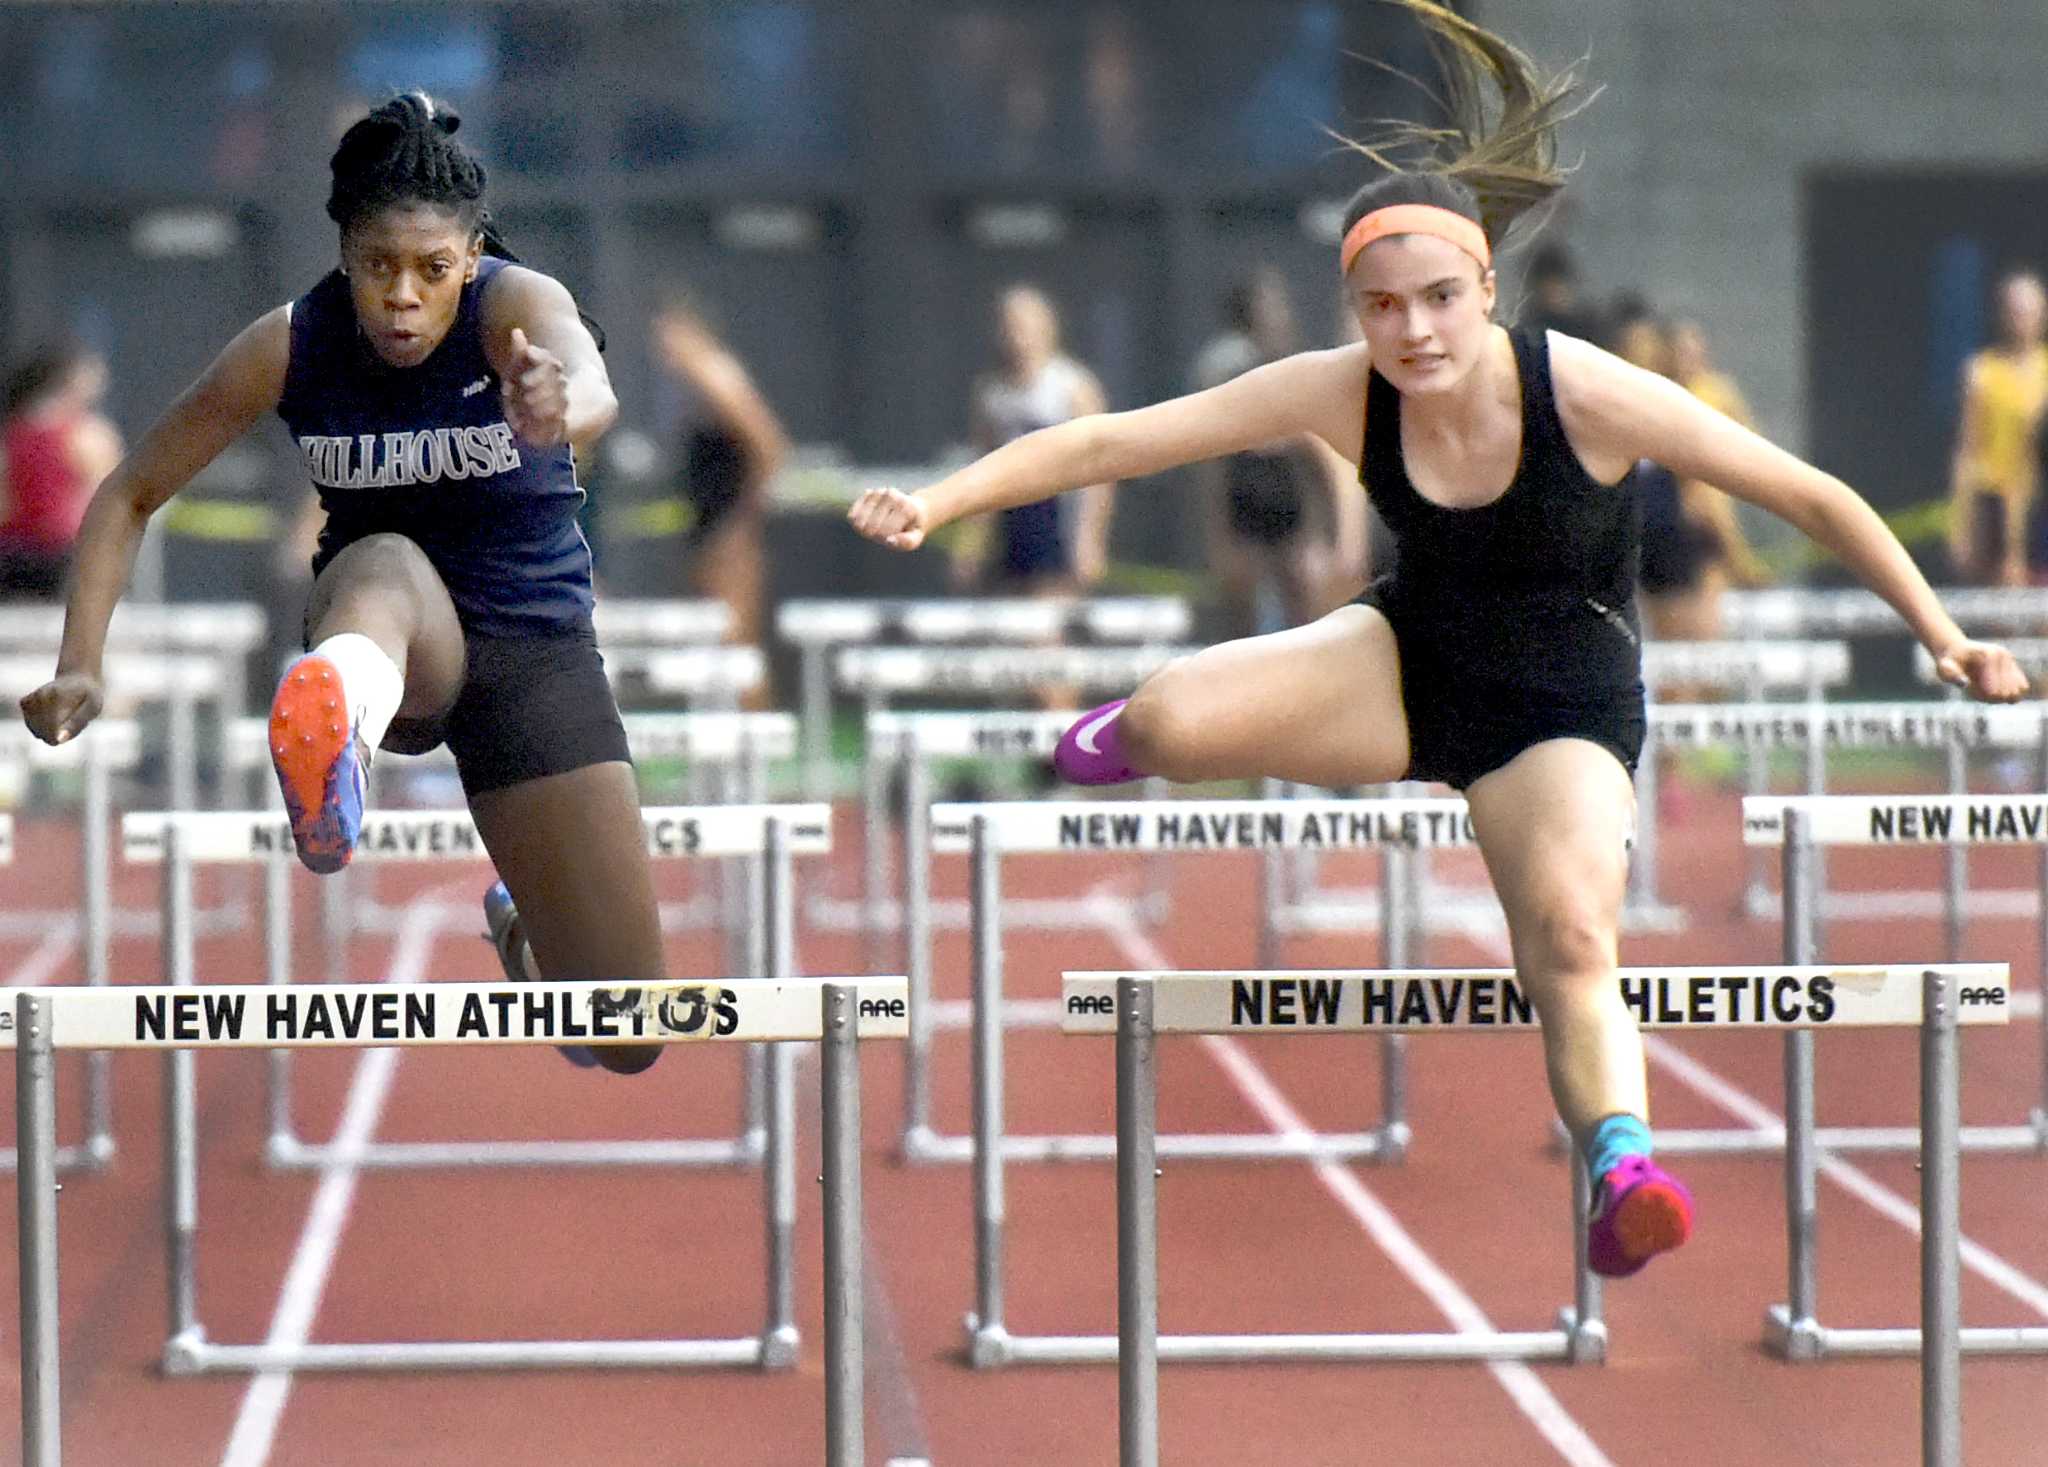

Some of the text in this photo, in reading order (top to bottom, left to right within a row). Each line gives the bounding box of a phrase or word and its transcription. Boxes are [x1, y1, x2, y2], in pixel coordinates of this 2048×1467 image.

[299, 422, 521, 490] HILLHOUSE
[1059, 810, 1476, 847] NEW HAVEN ATHLETIC
[1869, 803, 2048, 841] NEW HAV
[135, 988, 739, 1041] NEW HAVEN ATHLES
[1231, 975, 1836, 1025] NEW HAVEN HLETICS
